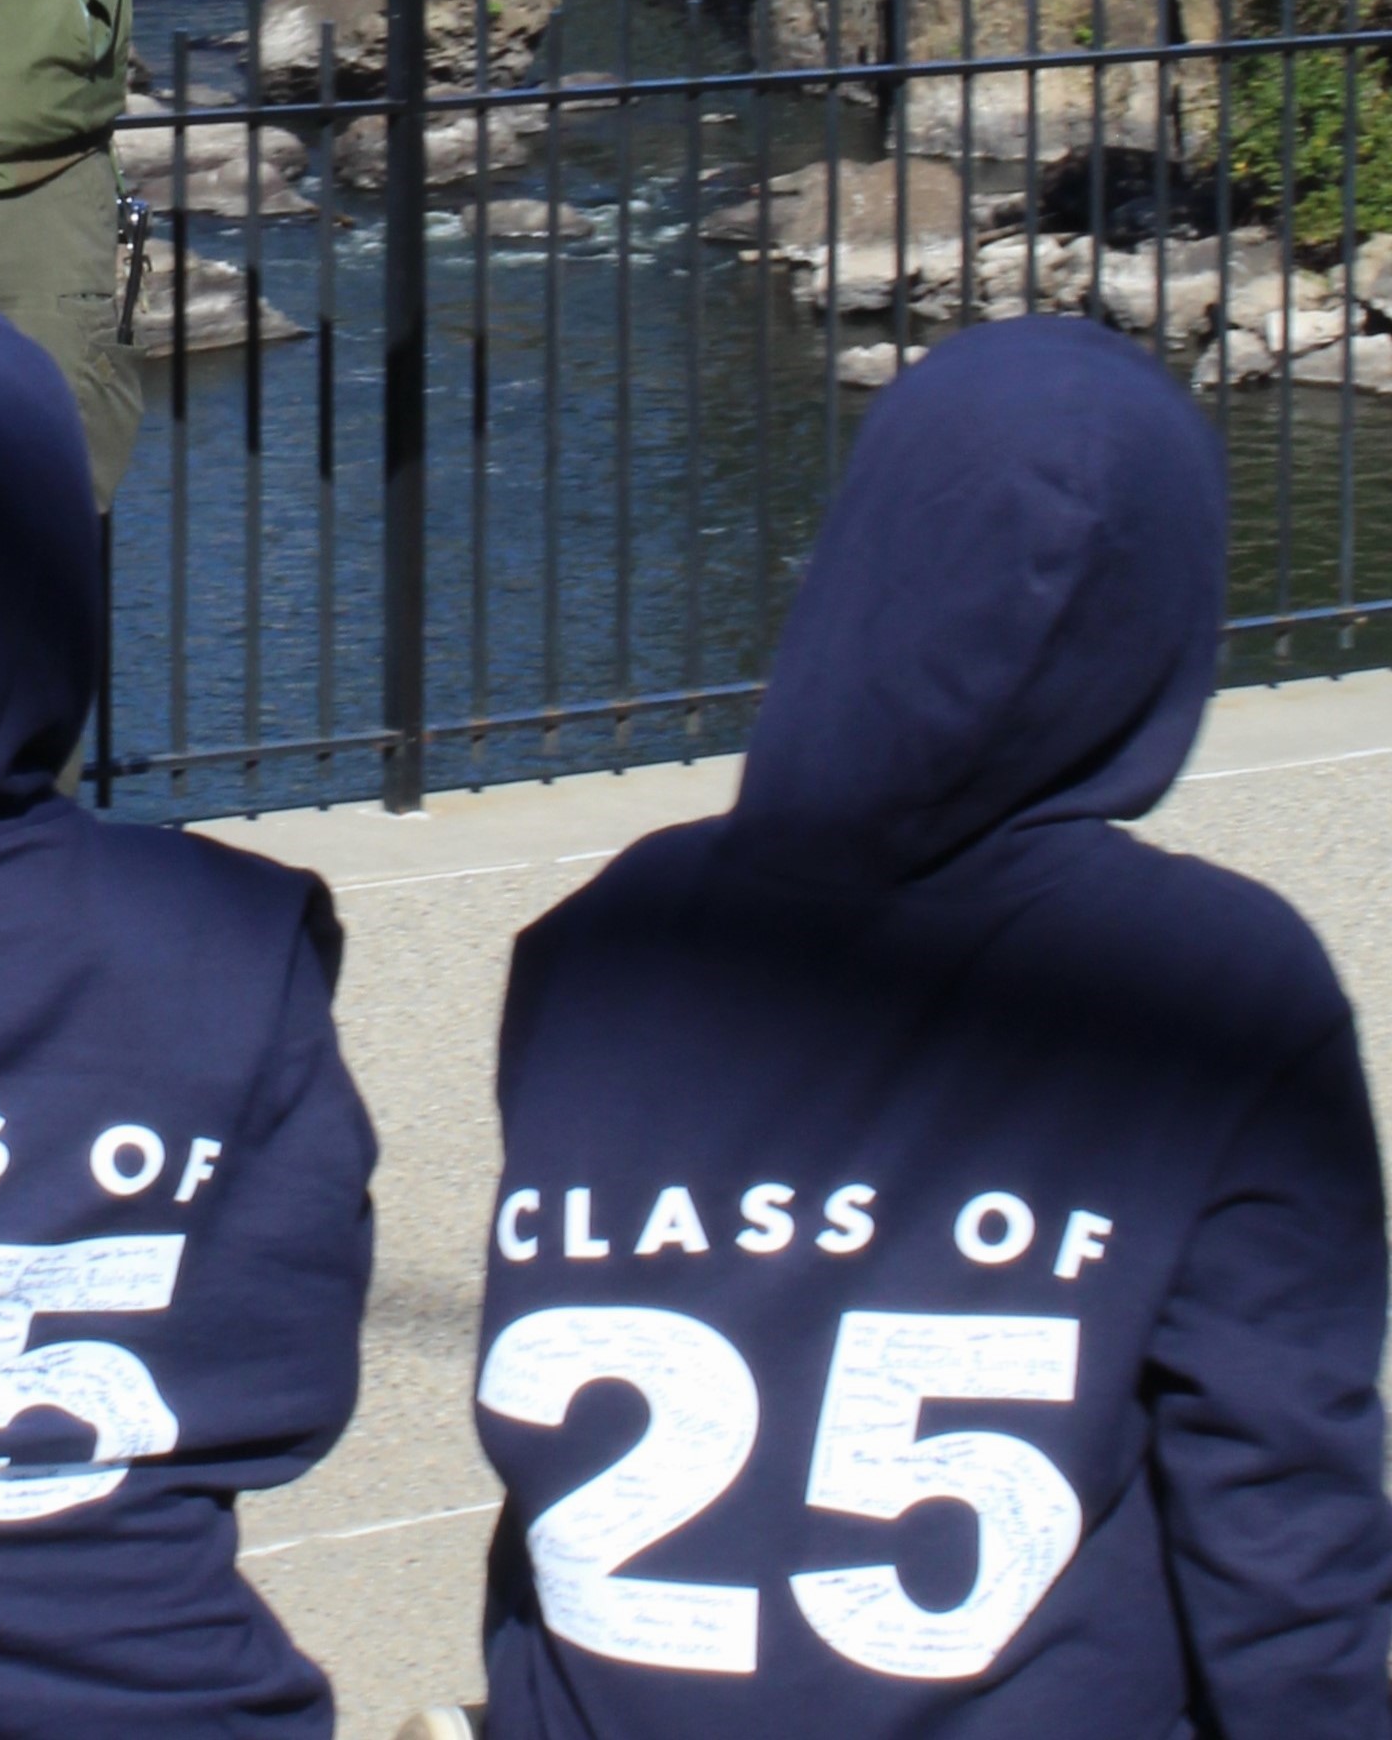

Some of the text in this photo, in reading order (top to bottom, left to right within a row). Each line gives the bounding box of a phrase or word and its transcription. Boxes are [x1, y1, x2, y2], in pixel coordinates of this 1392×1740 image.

[89, 1124, 222, 1203] OF
[497, 1182, 1113, 1280] CLASS OF
[477, 1305, 1083, 1680] 25
